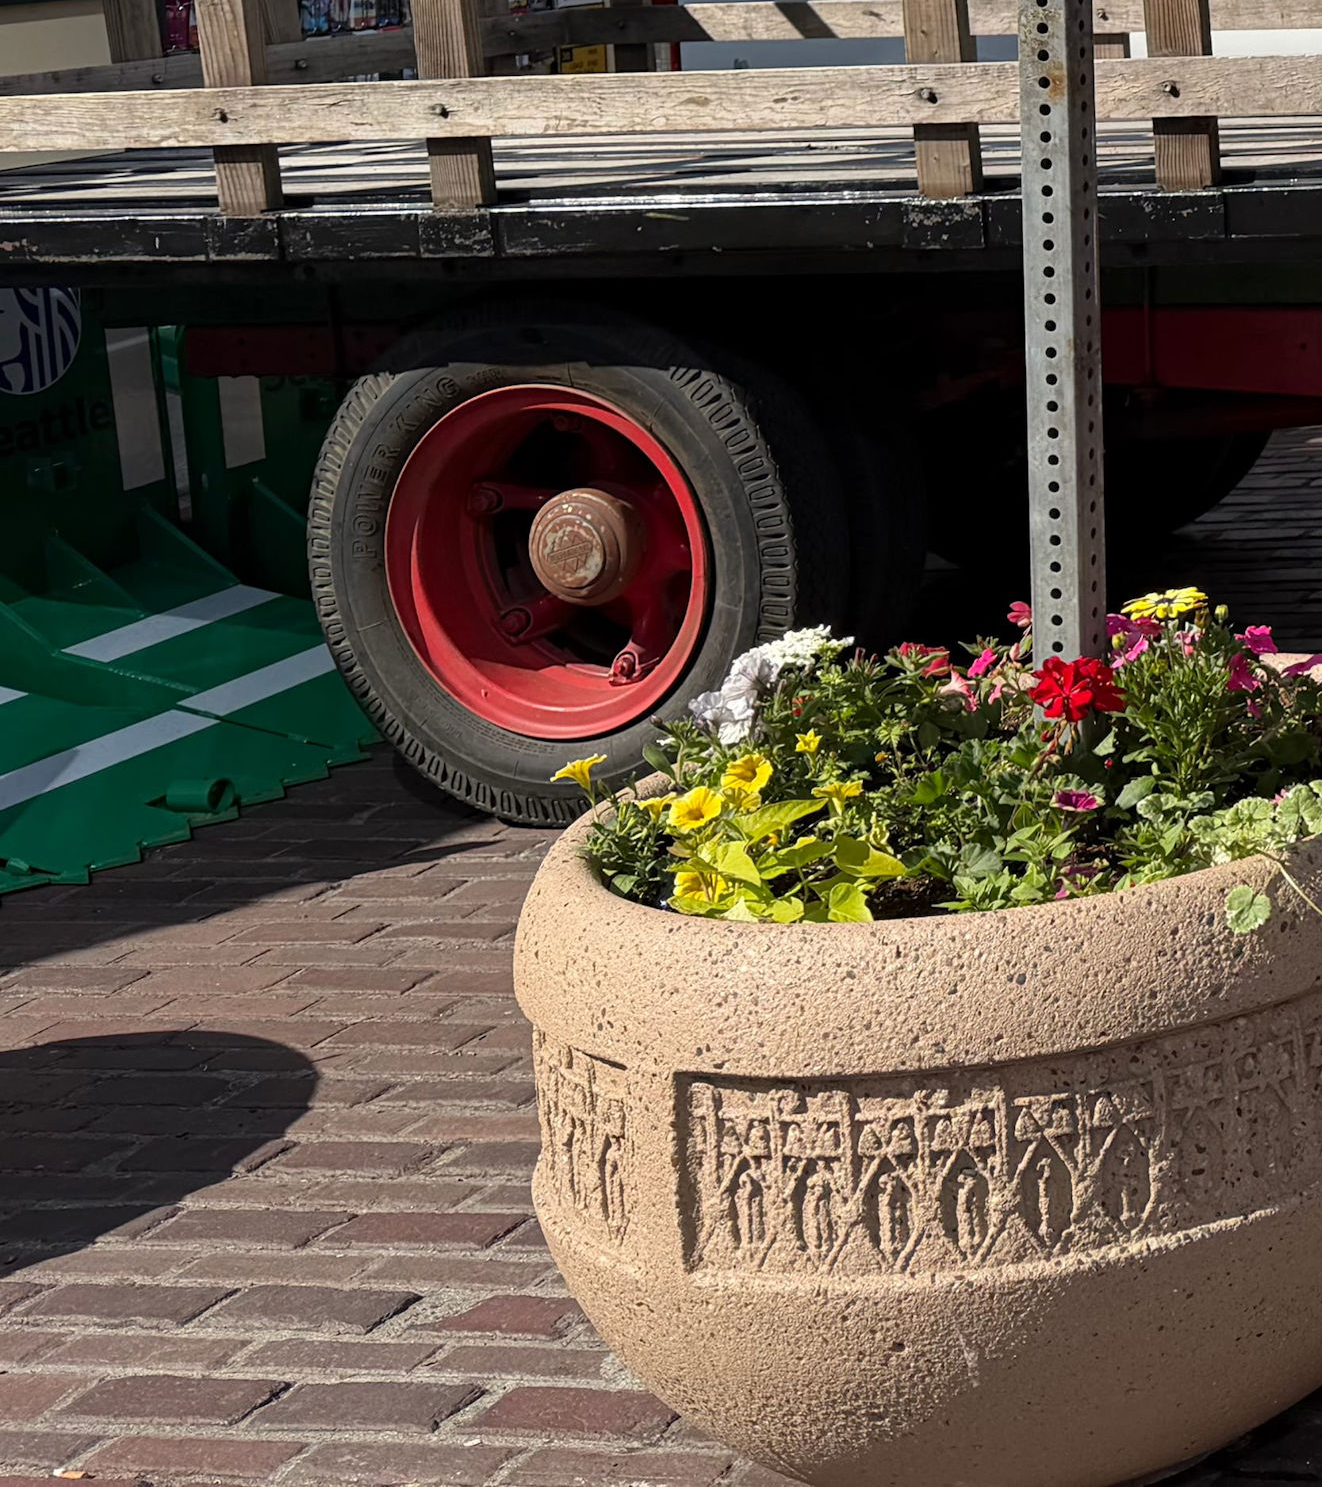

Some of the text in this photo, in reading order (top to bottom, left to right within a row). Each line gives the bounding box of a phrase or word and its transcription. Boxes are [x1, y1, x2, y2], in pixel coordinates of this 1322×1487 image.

[0, 396, 112, 457] eattle
[352, 376, 462, 560] POWER KING
